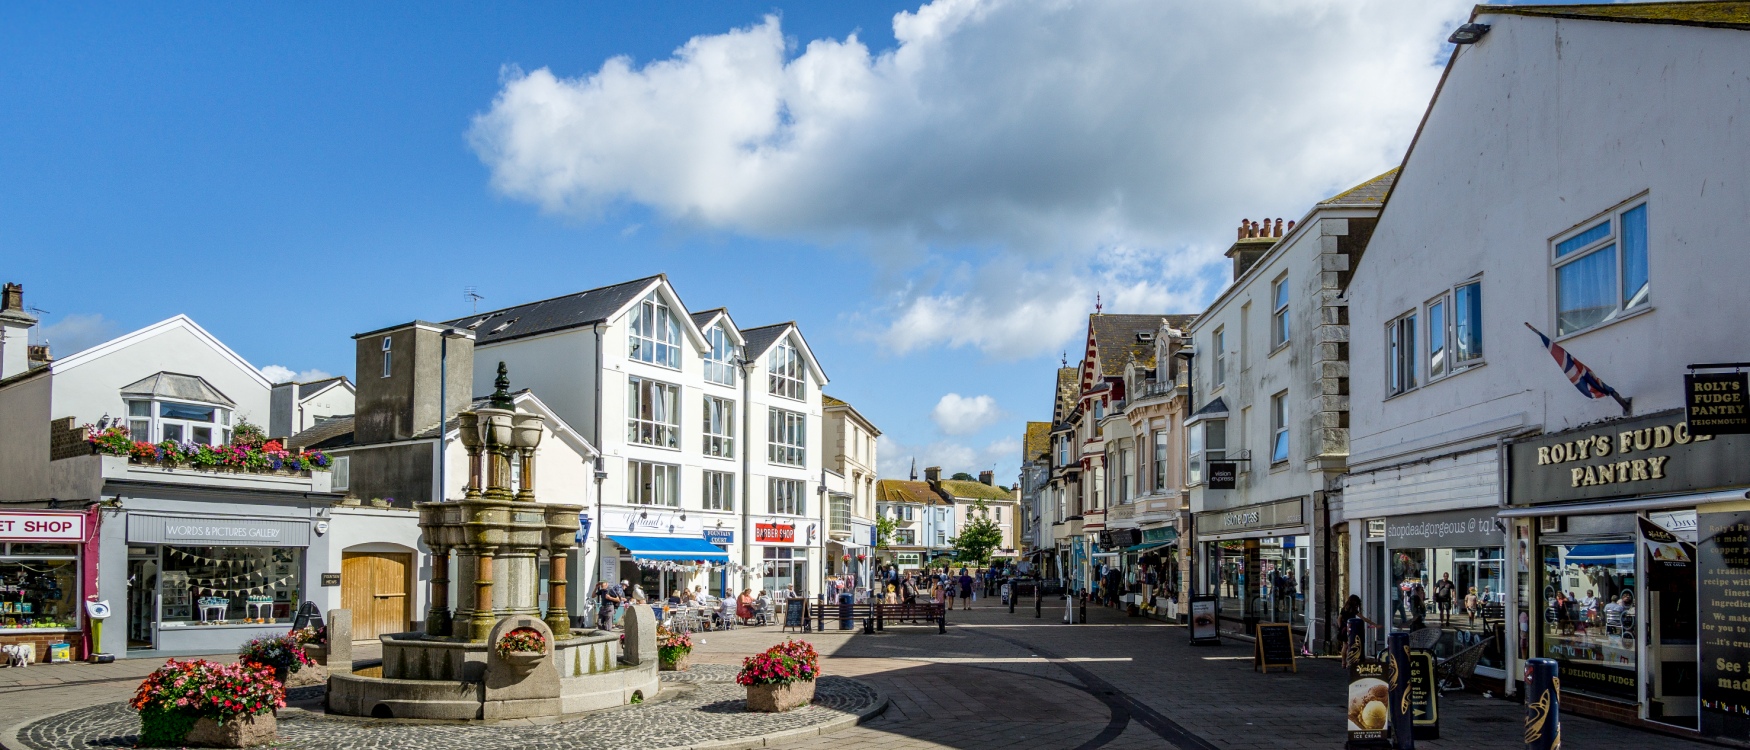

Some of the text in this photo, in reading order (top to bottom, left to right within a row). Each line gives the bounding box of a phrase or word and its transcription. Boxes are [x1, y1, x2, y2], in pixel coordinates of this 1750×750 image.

[1694, 381, 1740, 391] ROLY'S
[1694, 393, 1741, 403] FUDGE
[1691, 405, 1745, 415] PANTRY
[1691, 418, 1747, 426] TEIGNMOUTH
[1537, 422, 1713, 465] ROLY'S FUDG
[1571, 456, 1667, 487] PANTRY
[24, 521, 72, 532] SHOP
[167, 525, 280, 537] WORDS & PICTURES GALLERY
[1388, 521, 1465, 538] shopdeadgorgeous
[1467, 517, 1476, 533] @
[756, 528, 793, 538] BARBER SHOP
[1724, 535, 1748, 543] made
[1724, 557, 1749, 565] using
[1703, 578, 1750, 586] recipe wit
[1712, 613, 1726, 621] We
[1716, 657, 1741, 673] See
[1568, 668, 1606, 681] DELICIOUS
[1608, 674, 1635, 687] FUDGE
